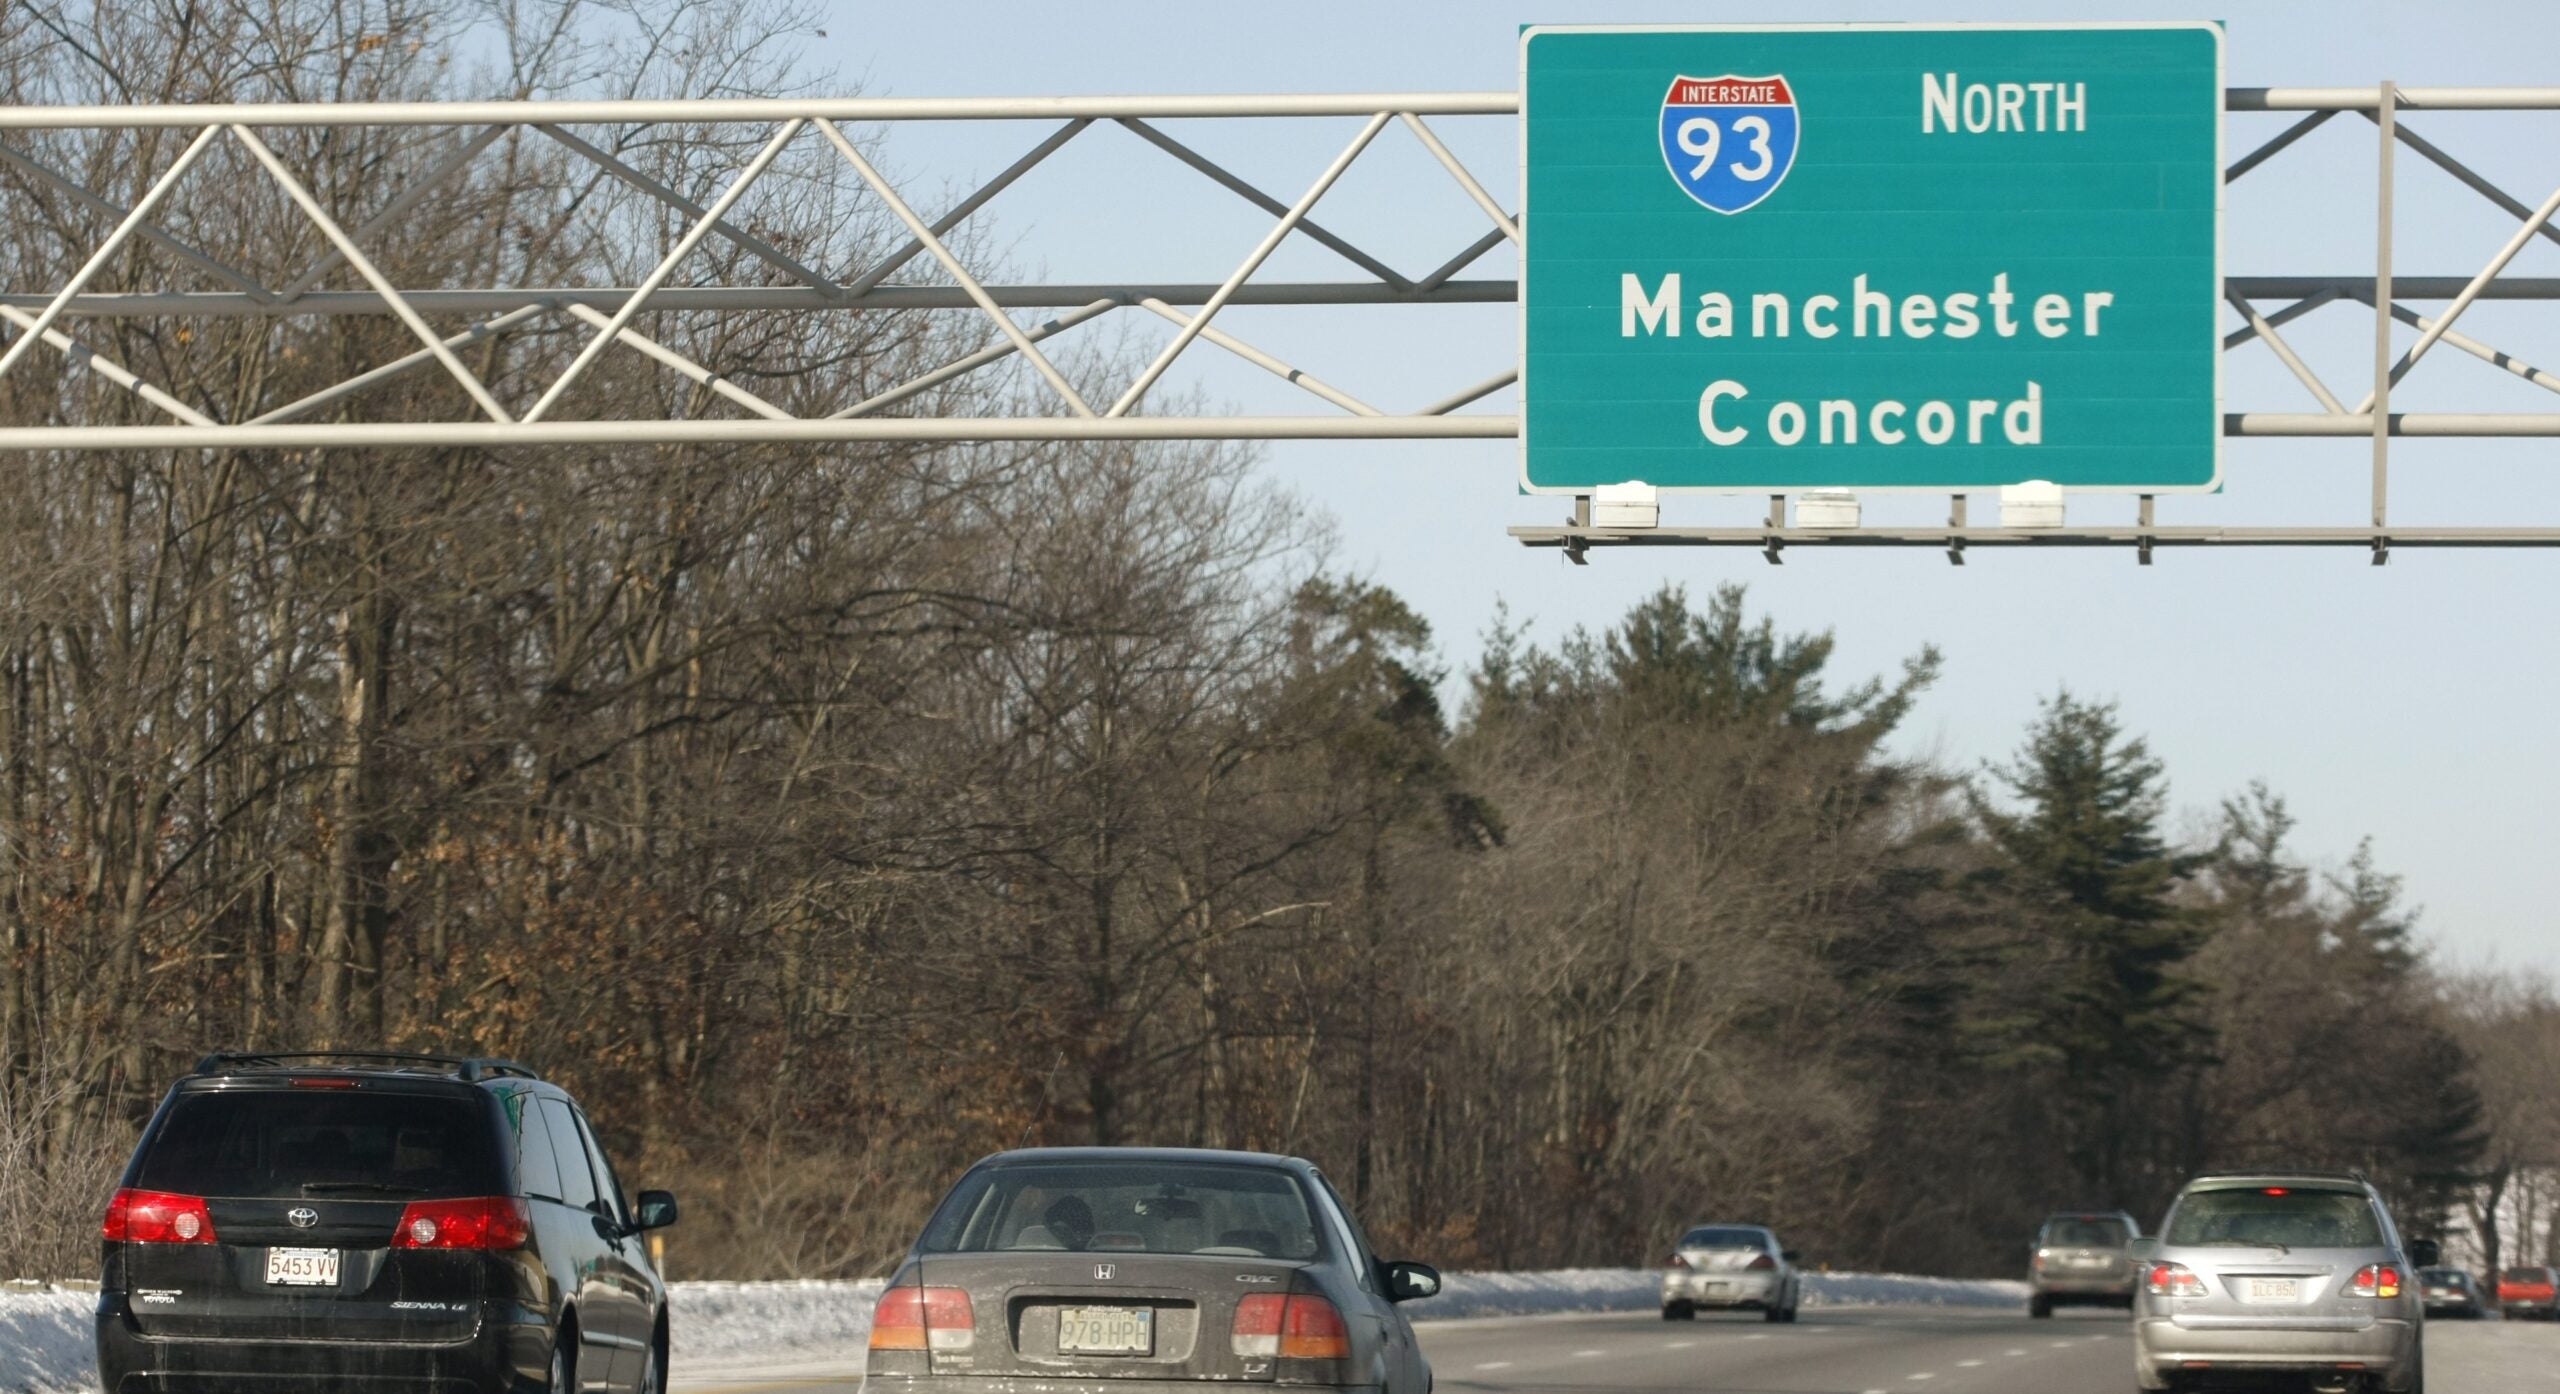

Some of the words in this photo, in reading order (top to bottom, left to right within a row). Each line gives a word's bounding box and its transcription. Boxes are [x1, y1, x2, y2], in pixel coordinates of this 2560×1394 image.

[1682, 85, 1776, 102] INTERSTATE
[1922, 72, 2086, 134] NORTH
[1677, 115, 1773, 182] 93
[1620, 272, 2114, 339] Manchester
[1698, 379, 2043, 446] Concord
[271, 1257, 312, 1276] 5453
[317, 1258, 337, 1277] VV
[142, 1295, 176, 1304] TOYOTA
[390, 1301, 447, 1310] SIENNA
